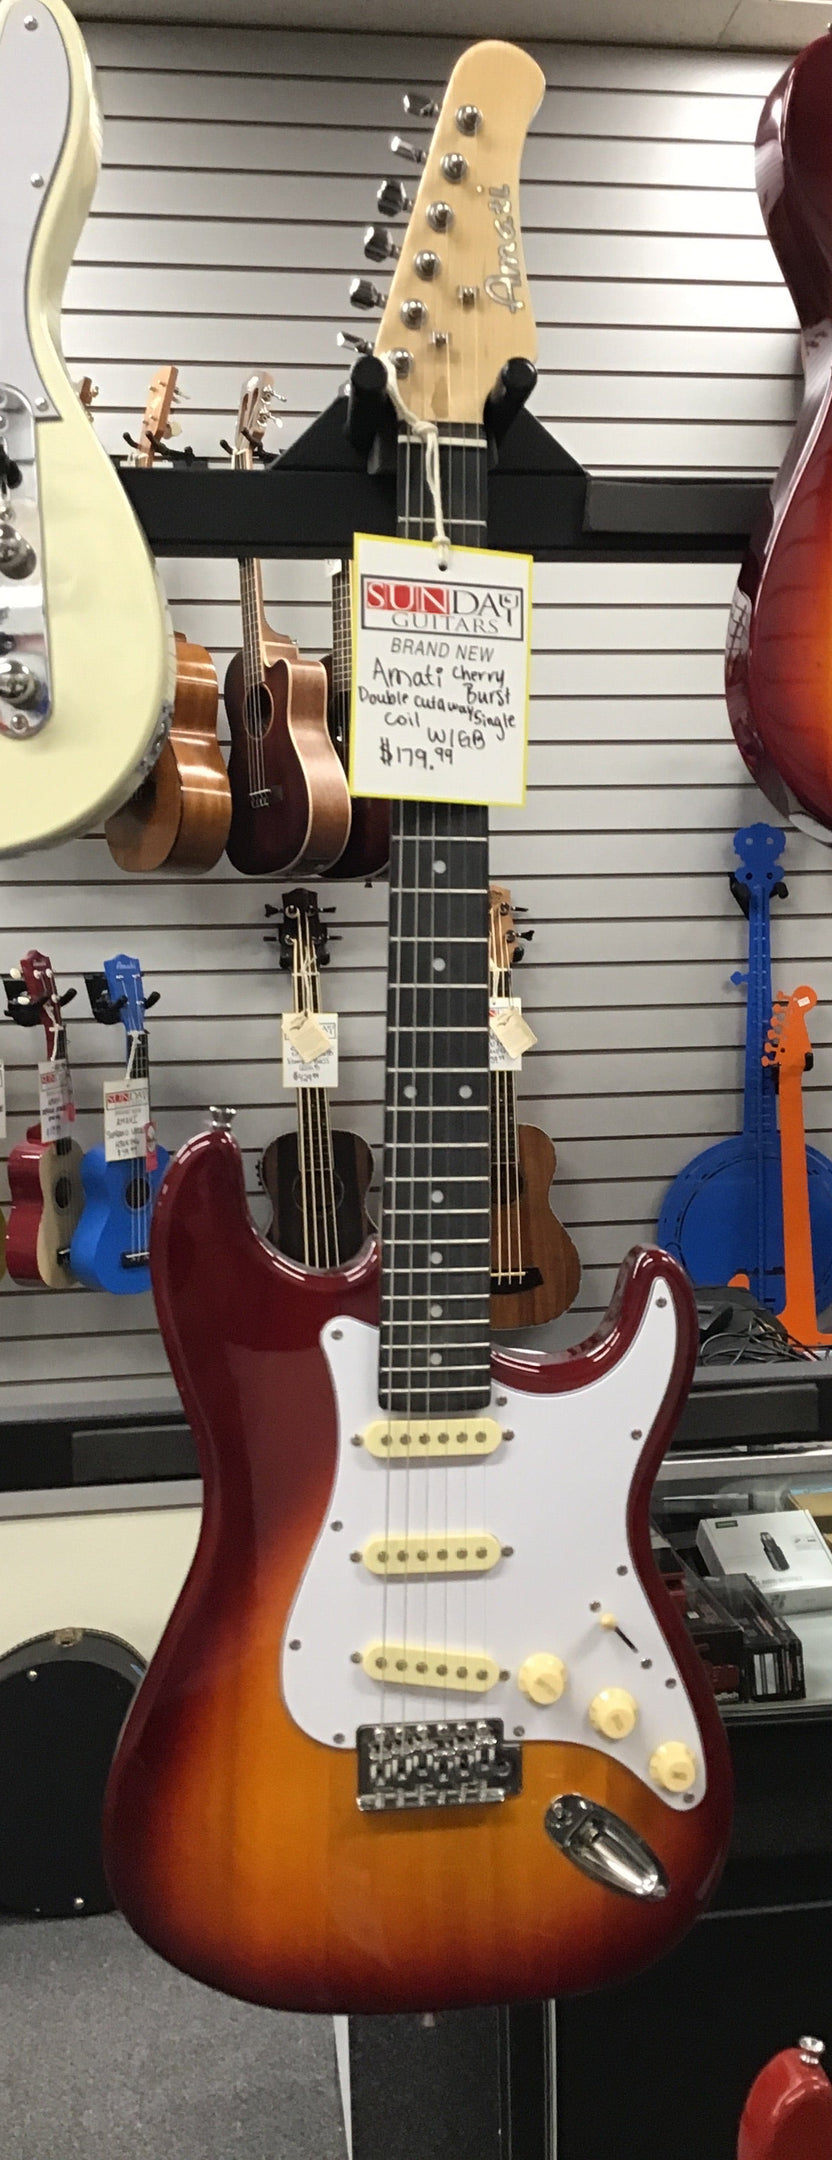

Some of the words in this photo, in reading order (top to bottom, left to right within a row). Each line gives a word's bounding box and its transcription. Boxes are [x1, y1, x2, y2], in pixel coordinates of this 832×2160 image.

[477, 183, 525, 314] Amati
[366, 580, 519, 627] SUNDAY
[391, 611, 500, 635] GUITARS
[390, 636, 450, 659] BRAND
[456, 644, 495, 663] NEW
[372, 656, 444, 688] Amati
[358, 685, 409, 705] Double
[413, 694, 474, 722] cutaway
[462, 682, 511, 706] Burst
